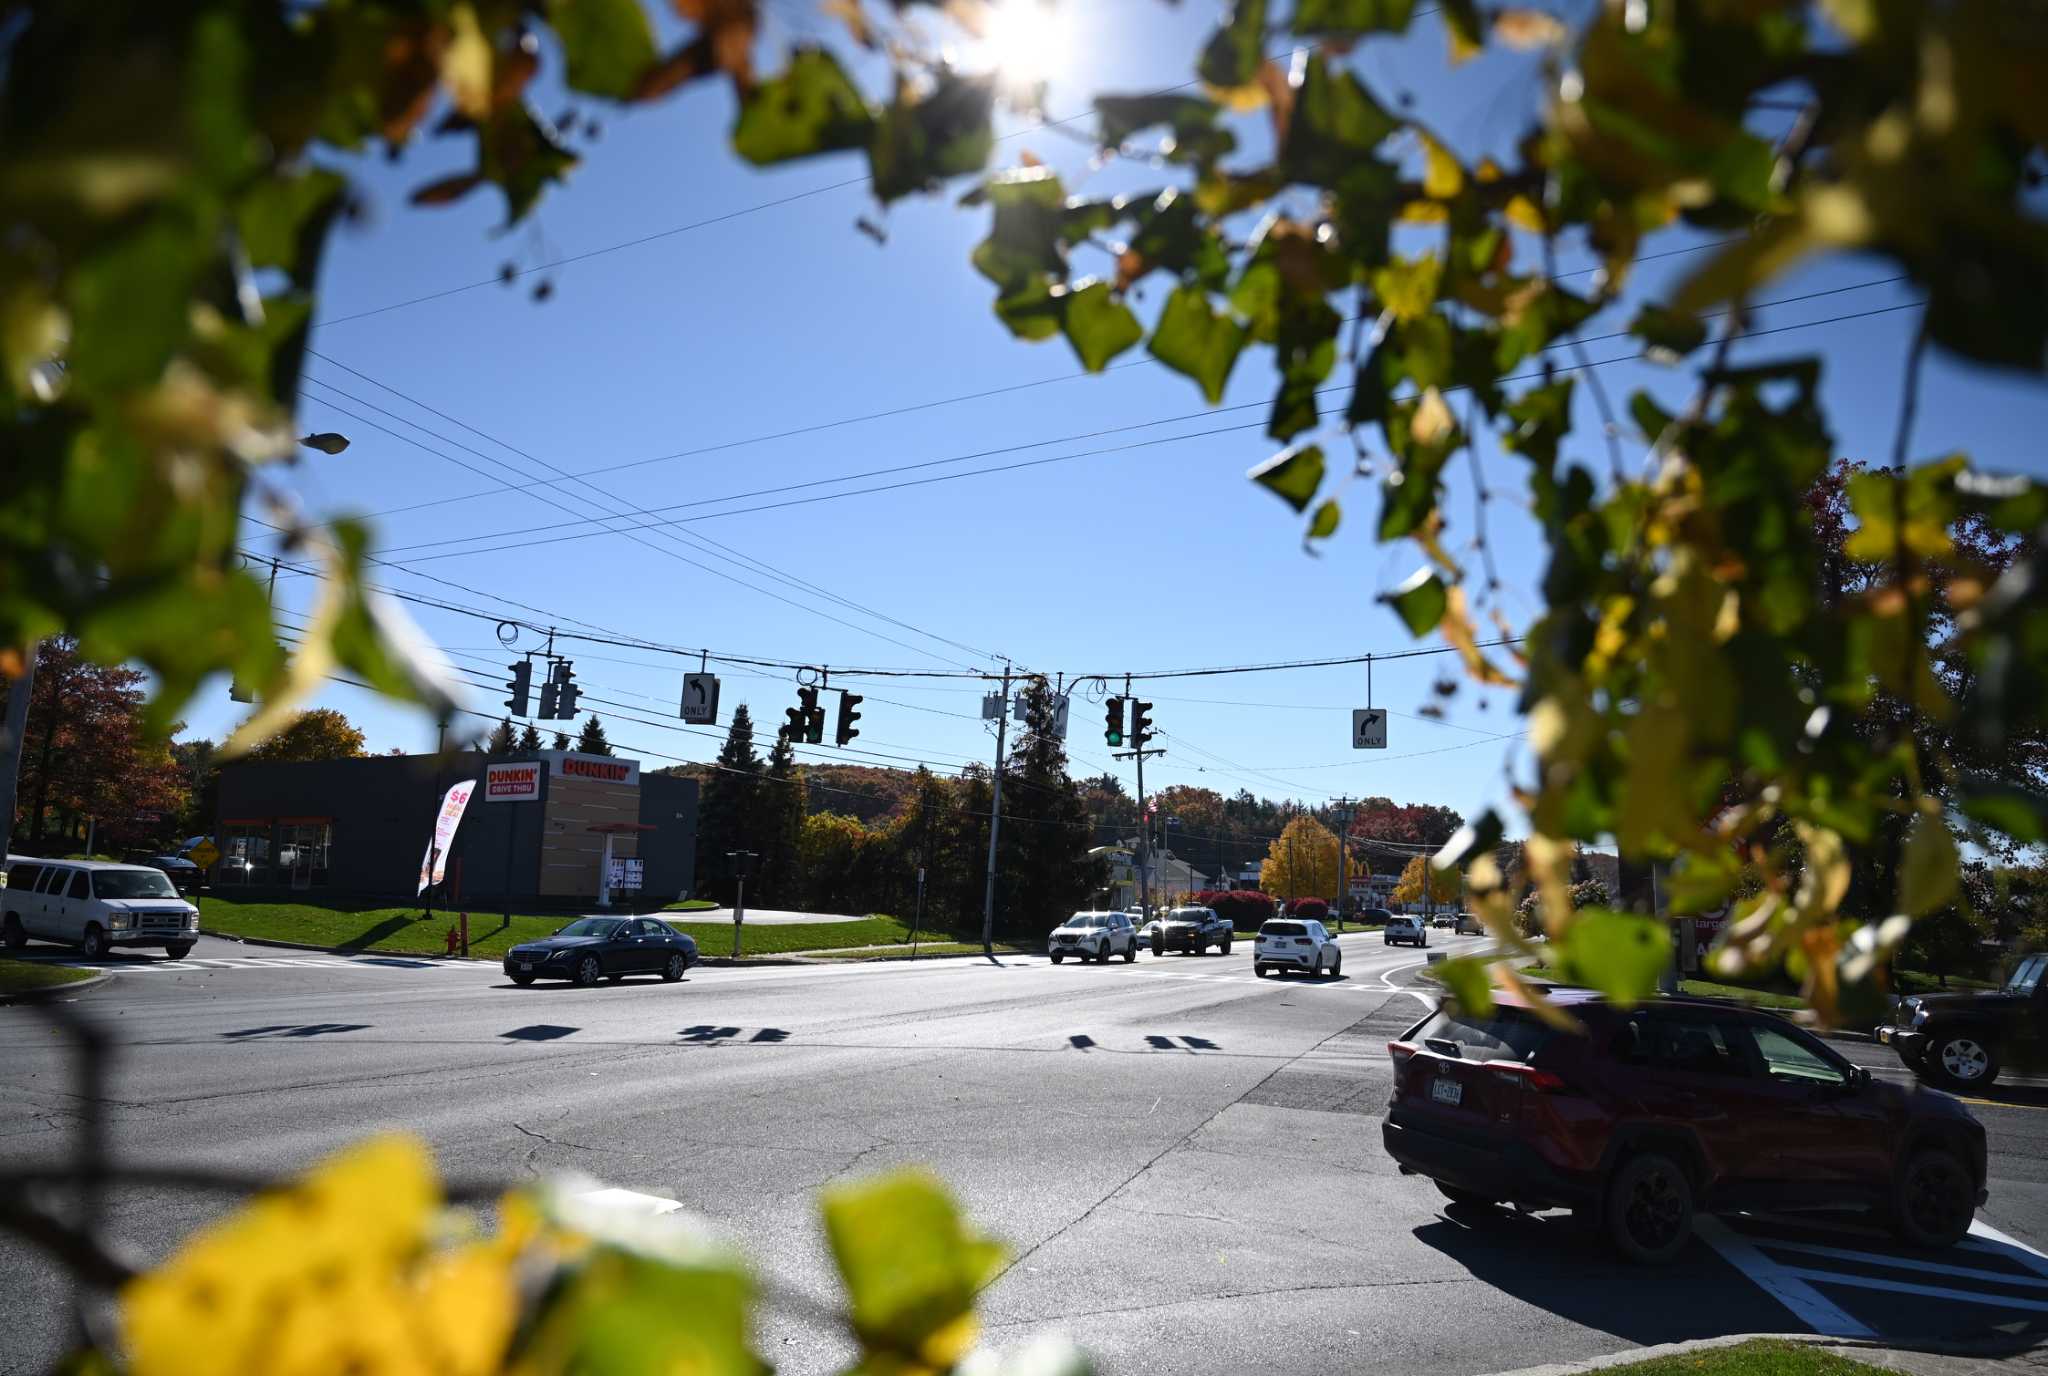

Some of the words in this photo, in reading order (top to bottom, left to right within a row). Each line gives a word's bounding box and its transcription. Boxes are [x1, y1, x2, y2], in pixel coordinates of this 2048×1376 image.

[684, 705, 708, 716] ONLY
[1357, 736, 1382, 745] ONLY
[488, 768, 537, 783] DUNKIN'
[563, 757, 631, 781] DUNKIN'
[492, 784, 512, 793] DRIVE
[513, 783, 532, 793] THRU
[450, 789, 468, 804] $6
